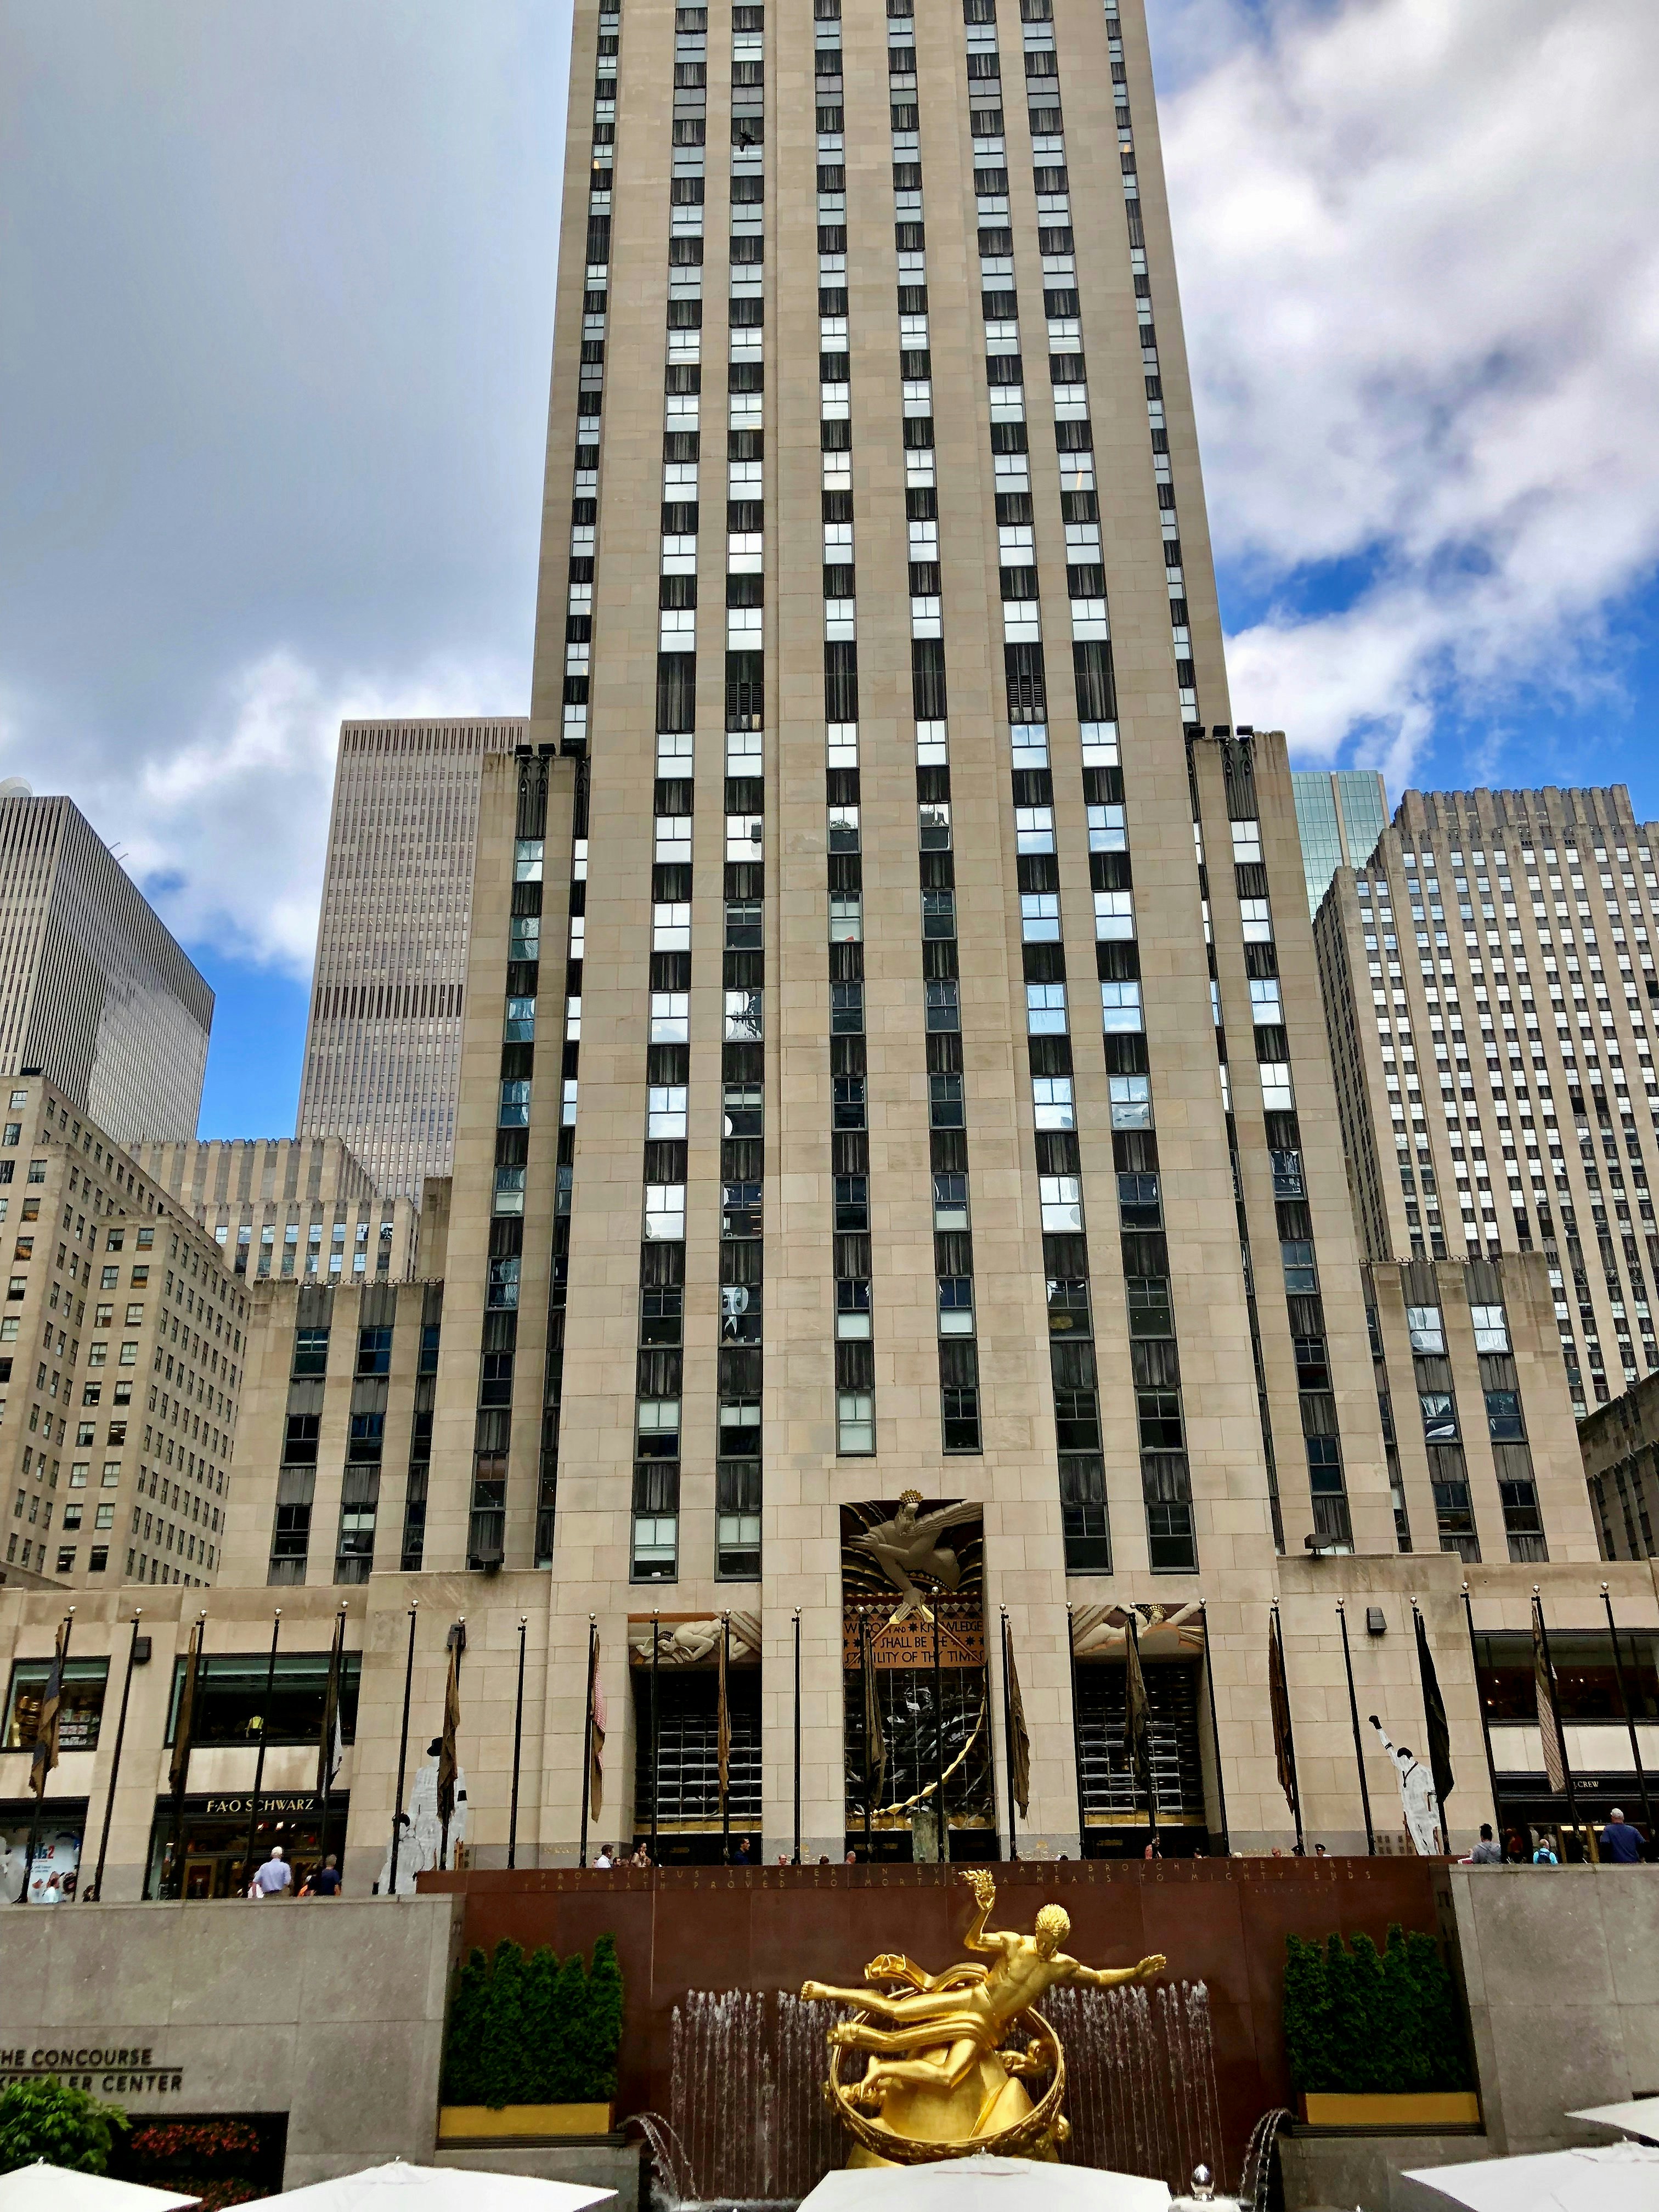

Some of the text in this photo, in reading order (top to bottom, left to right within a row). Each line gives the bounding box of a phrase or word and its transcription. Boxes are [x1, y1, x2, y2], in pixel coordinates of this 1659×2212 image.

[920, 1621, 983, 1633] KNWLEDGE
[881, 1636, 912, 1649] SHALL
[915, 1636, 927, 1647] BE
[845, 1651, 899, 1663] STILITY
[902, 1651, 918, 1662] OF
[947, 1651, 984, 1662] TIMES
[245, 1799, 314, 1812] SCHWARZ
[728, 1867, 837, 1877] TEACHER
[866, 1867, 888, 1875] IN
[1019, 1864, 1058, 1872] ART
[1224, 1860, 1265, 1869] THE
[693, 1880, 785, 1889] PROVED
[814, 1878, 838, 1887] TO
[865, 1877, 958, 1887] MORTAL
[1036, 1874, 1111, 1884] MEANS
[1141, 1873, 1164, 1882] TO
[0, 2047, 153, 2067] HE CONCOURSE
[102, 2074, 183, 2094] CENTER
